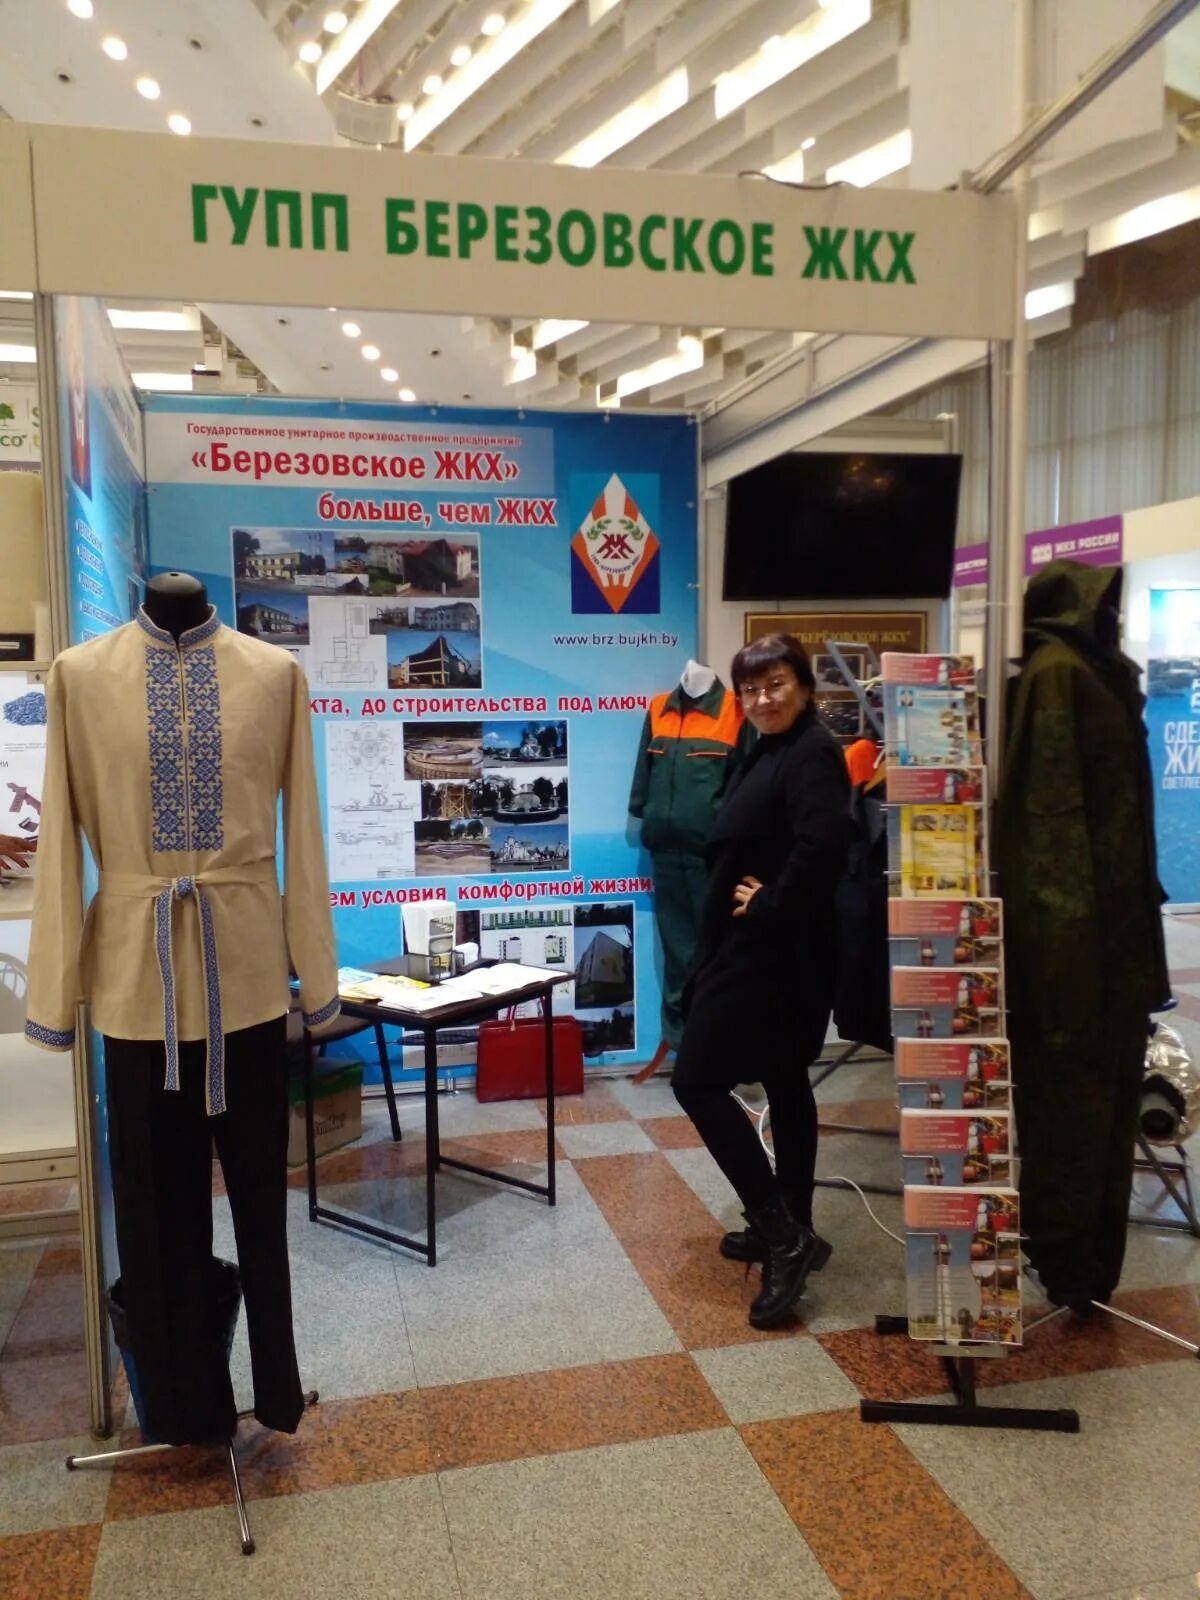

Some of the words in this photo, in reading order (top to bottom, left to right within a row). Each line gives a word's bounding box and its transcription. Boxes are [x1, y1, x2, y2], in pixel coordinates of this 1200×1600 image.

[191, 184, 348, 252] ГУПП
[385, 198, 773, 276] БЕРЕЗОВСКОЕ
[801, 226, 917, 284] ЖКХ
[187, 423, 285, 437] Государственное
[287, 429, 345, 440] унитарное
[348, 431, 450, 443] производственное
[191, 442, 426, 480] «Березовское
[434, 450, 519, 481] ЖКХ»
[318, 491, 431, 527] больше,
[438, 503, 491, 524] чем
[496, 499, 557, 526] ЖКХ
[1078, 532, 1120, 549] РОССИИ
[554, 633, 678, 648] www.brz.bujkh.by
[361, 698, 386, 716] до
[393, 697, 547, 717] строительства
[558, 697, 593, 713] под
[598, 696, 647, 711] ключ
[361, 887, 446, 909] условия
[458, 877, 584, 902] комфортной
